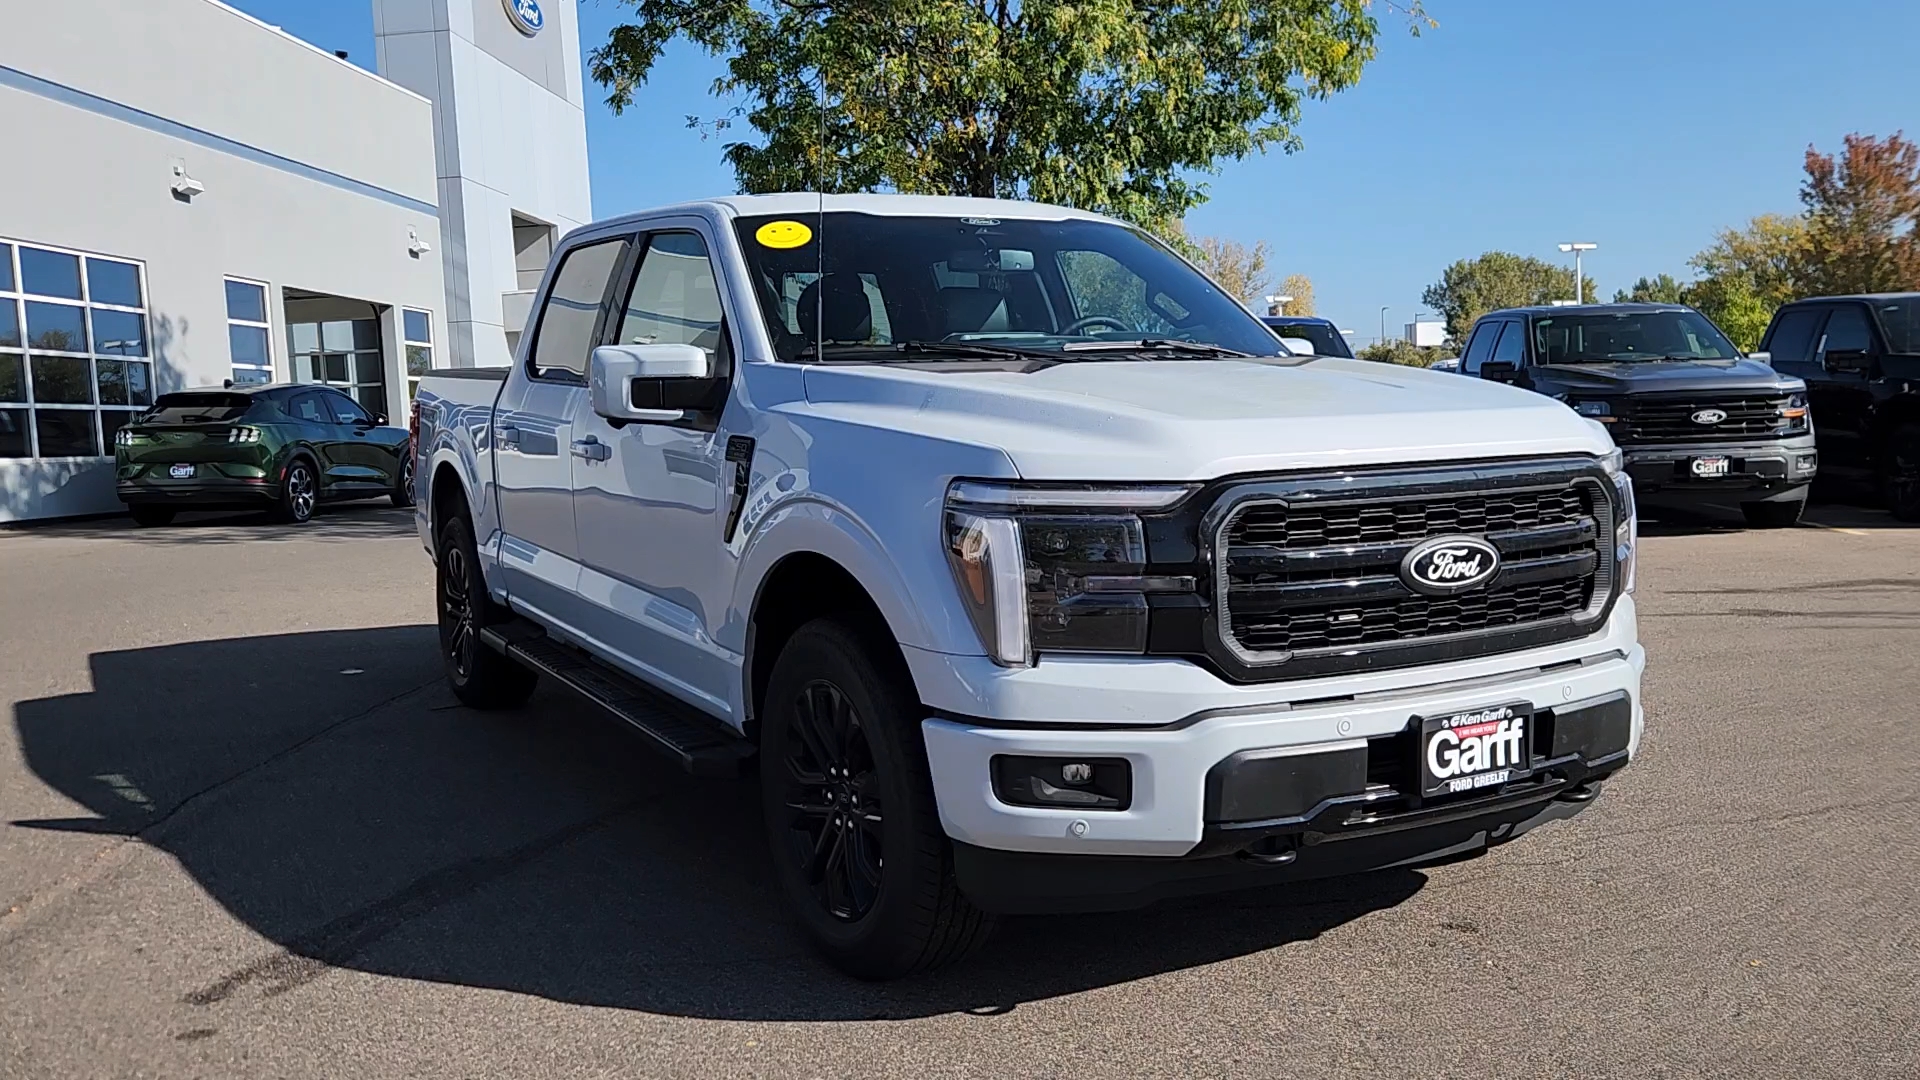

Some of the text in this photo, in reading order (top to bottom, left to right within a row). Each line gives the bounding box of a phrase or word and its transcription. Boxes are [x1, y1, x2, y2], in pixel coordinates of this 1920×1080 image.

[1697, 412, 1718, 422] Ford
[169, 466, 195, 476] Garff
[1692, 459, 1729, 474] Garff
[1428, 548, 1481, 580] Ford
[1460, 707, 1506, 726] Ken Garff
[1427, 717, 1523, 779] Garff
[1450, 771, 1509, 792] FORD GREELEY
